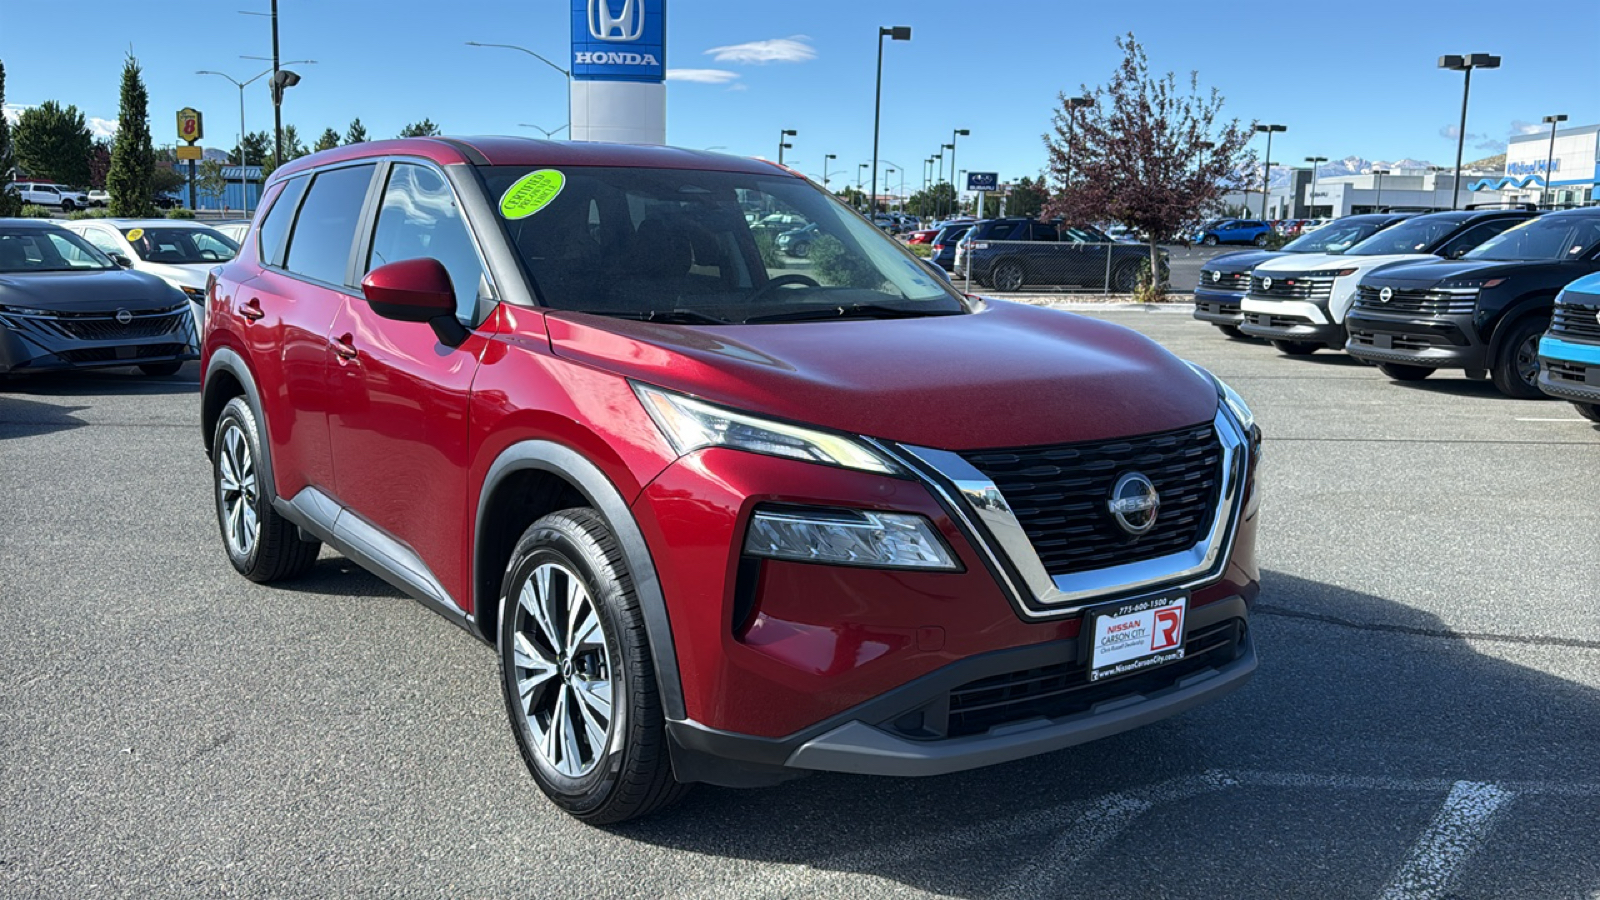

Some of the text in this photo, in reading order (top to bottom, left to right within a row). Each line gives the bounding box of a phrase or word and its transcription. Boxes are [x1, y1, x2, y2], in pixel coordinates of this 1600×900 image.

[575, 52, 660, 66] HONDA
[183, 119, 196, 135] 8
[504, 174, 545, 210] CERTIFIED
[1119, 598, 1168, 615] 775-600-1500
[1107, 620, 1141, 635] NISSAN
[1157, 610, 1179, 647] R
[1101, 628, 1146, 647] CARSON CITY
[1100, 654, 1177, 677] www.NissanCarsonCity.com
